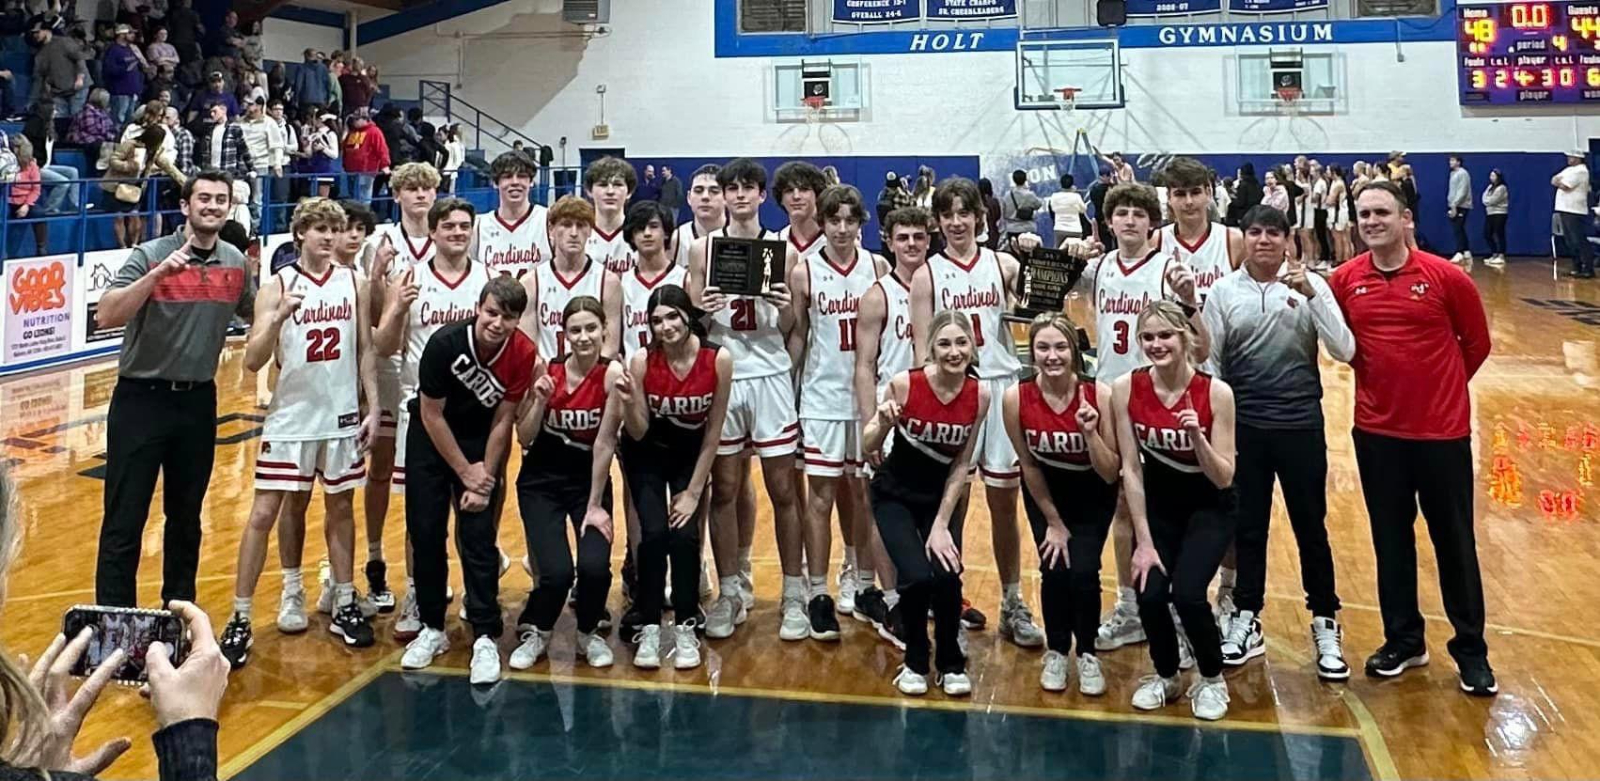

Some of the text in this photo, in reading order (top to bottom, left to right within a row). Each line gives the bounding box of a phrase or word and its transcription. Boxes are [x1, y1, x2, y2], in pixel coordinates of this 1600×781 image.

[851, 10, 883, 18] OVERALL
[1511, 5, 1547, 27] 0.0
[910, 33, 984, 51] HOLT
[1159, 24, 1333, 44] GYMNASIUM
[1464, 20, 1494, 42] 48
[1517, 41, 1545, 51] period
[1518, 55, 1546, 67] player
[1472, 69, 1485, 88] 3
[1495, 69, 1508, 88] 2
[1541, 69, 1553, 87] 3
[485, 242, 541, 267] Cardinals
[12, 261, 66, 294] GOOD
[1030, 266, 1069, 284] HAMPIONS
[9, 287, 66, 315] VIBES
[818, 289, 860, 315] Cardin
[942, 282, 1000, 310] Cardinals
[23, 313, 70, 328] NUTRITION
[421, 301, 480, 326] Cardinal
[730, 299, 757, 331] 21
[306, 327, 341, 363] 22
[1112, 320, 1129, 355] 3
[451, 353, 504, 408] CARDS
[648, 392, 713, 416] CARDS
[547, 408, 601, 430] ARDS
[906, 417, 973, 446] CARDS
[1025, 429, 1086, 453] CARD
[1134, 423, 1200, 451] CARD
